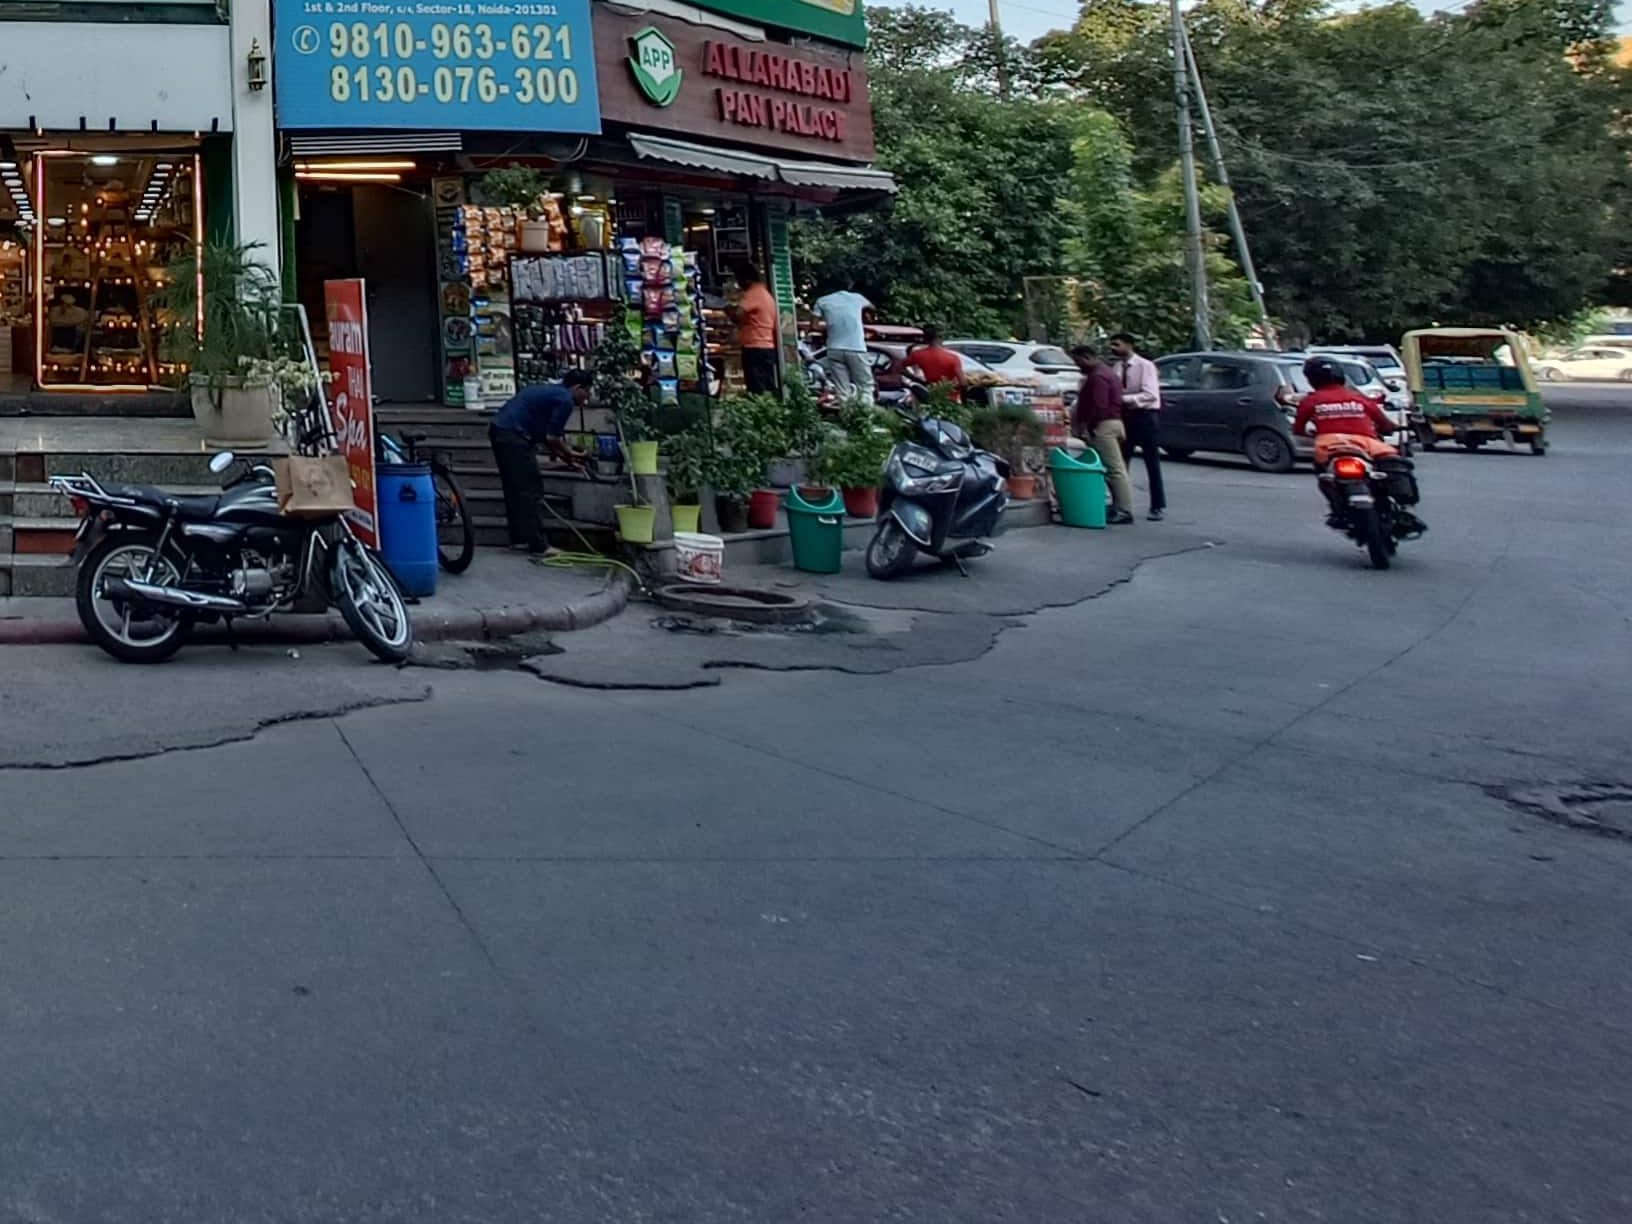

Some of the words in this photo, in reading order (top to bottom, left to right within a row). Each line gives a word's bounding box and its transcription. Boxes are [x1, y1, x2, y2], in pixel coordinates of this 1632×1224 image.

[303, 2, 323, 14] 1st
[324, 2, 334, 14] &
[336, 2, 359, 14] 2nd
[360, 2, 395, 16] Floor,
[328, 21, 573, 61] 9810-963-621
[642, 44, 670, 70] APP
[330, 64, 580, 105] 8130-076-300
[706, 40, 855, 102] ALLAHABADI
[721, 88, 768, 126] PAN
[771, 99, 848, 141] PALACE
[335, 392, 368, 456] Spa
